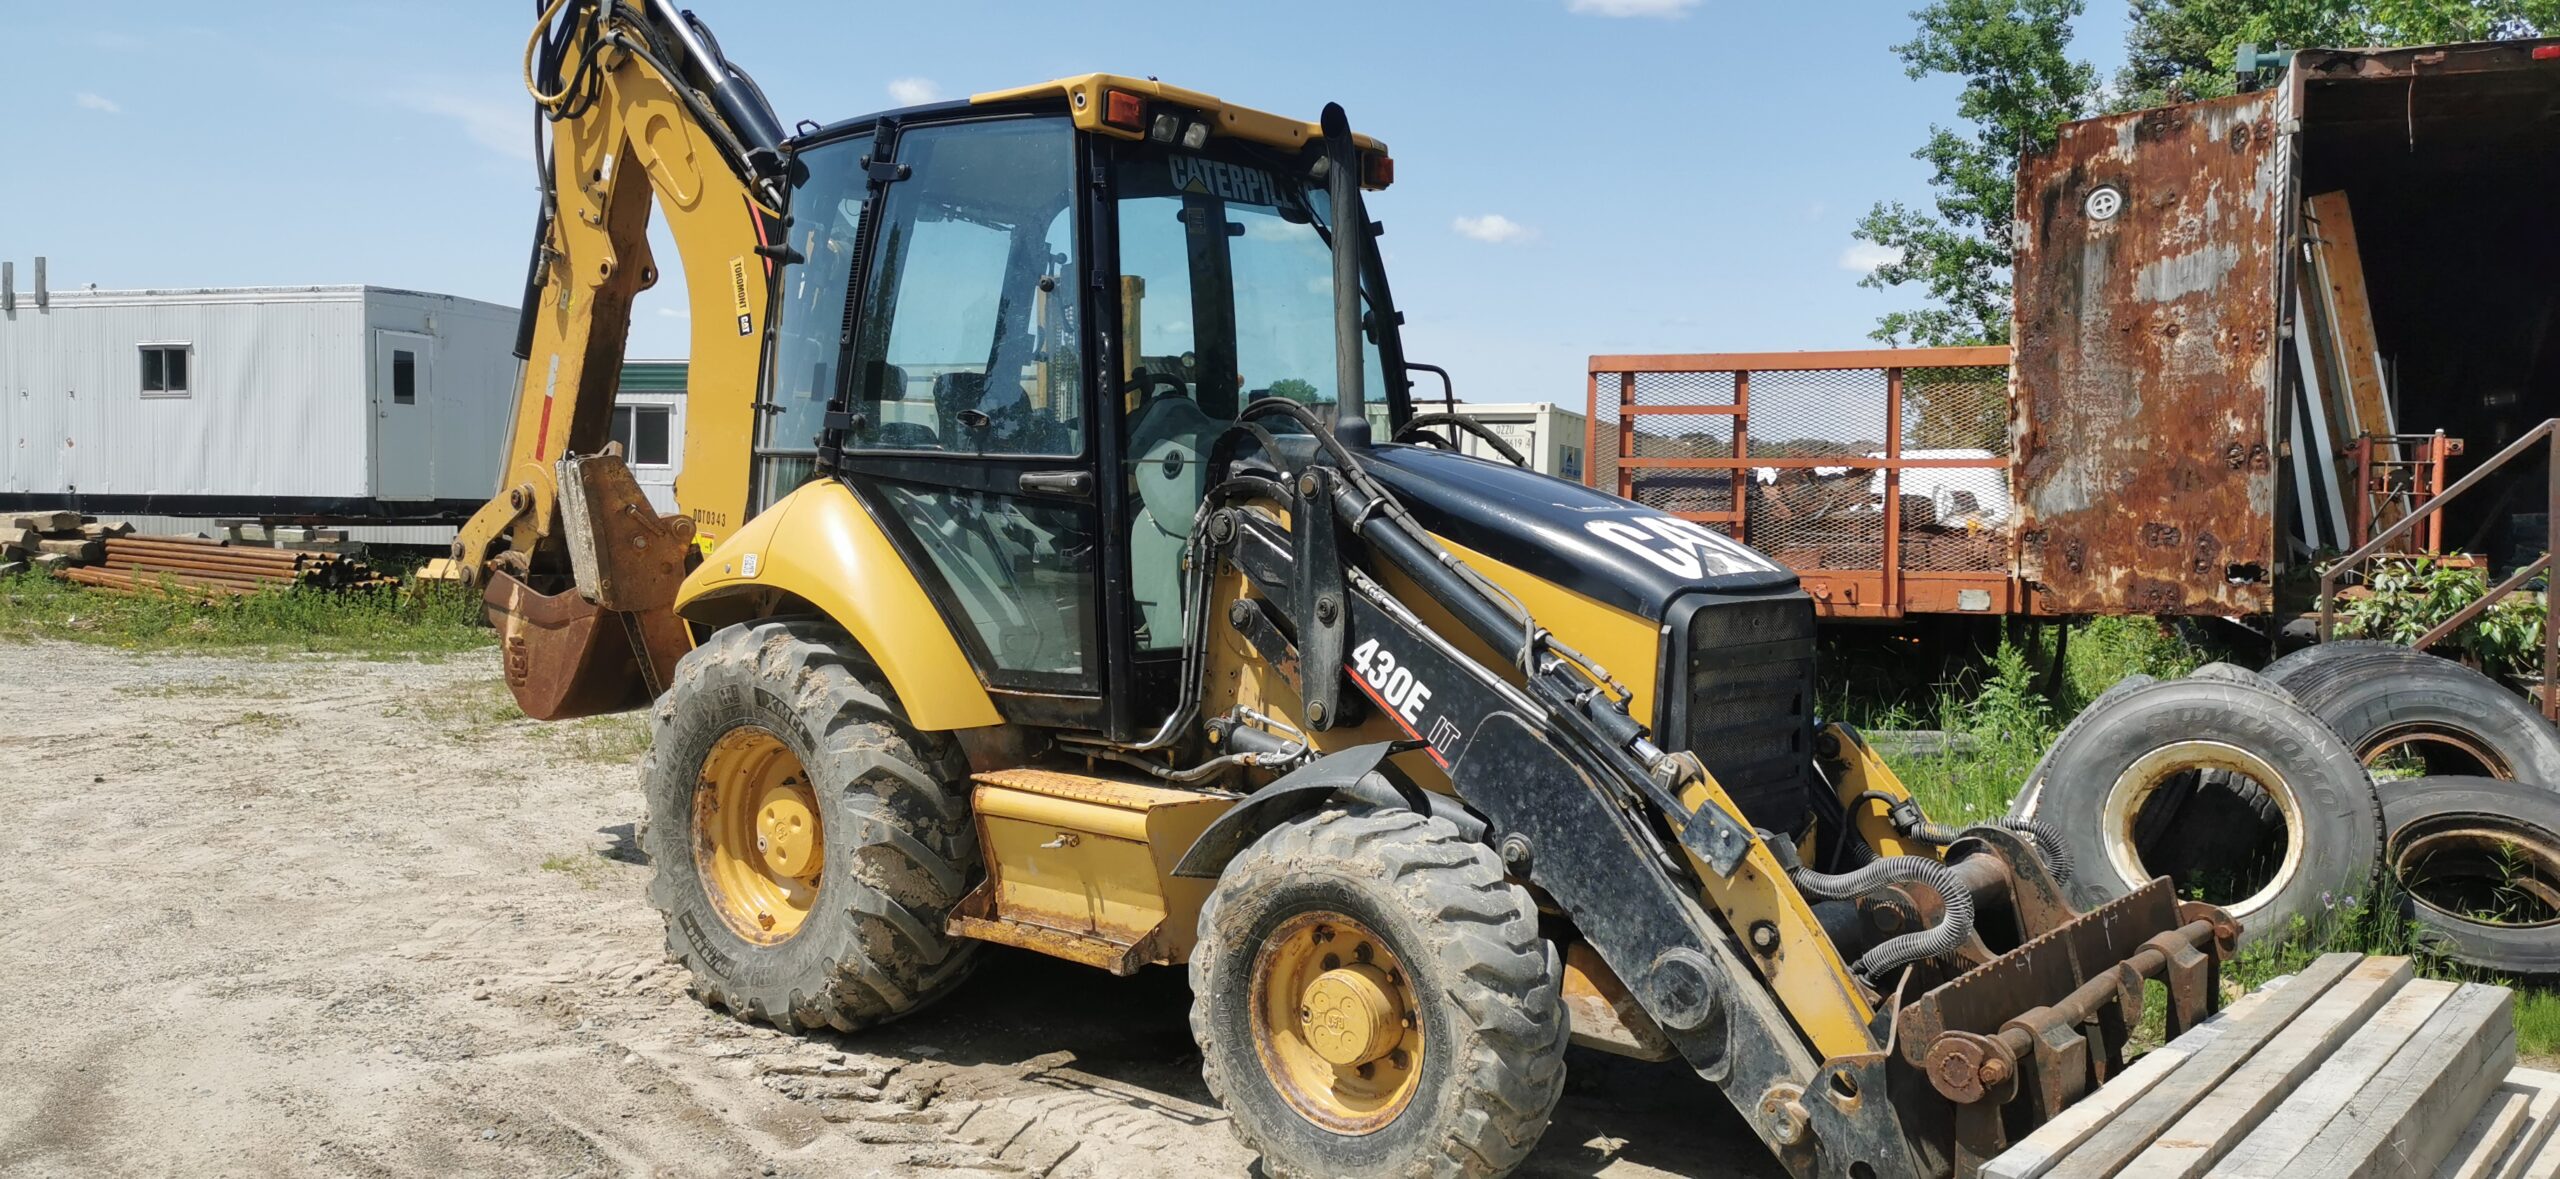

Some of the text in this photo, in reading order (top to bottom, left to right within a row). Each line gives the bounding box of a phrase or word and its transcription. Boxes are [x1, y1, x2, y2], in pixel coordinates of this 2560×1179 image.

[1168, 154, 1312, 209] CATERPILL
[734, 262, 750, 333] TOROMONT CAT
[1584, 517, 1781, 579] CAT
[766, 694, 806, 739] XMCL
[1352, 638, 1461, 754] 430E IT
[2145, 706, 2340, 811] SUMITOMO
